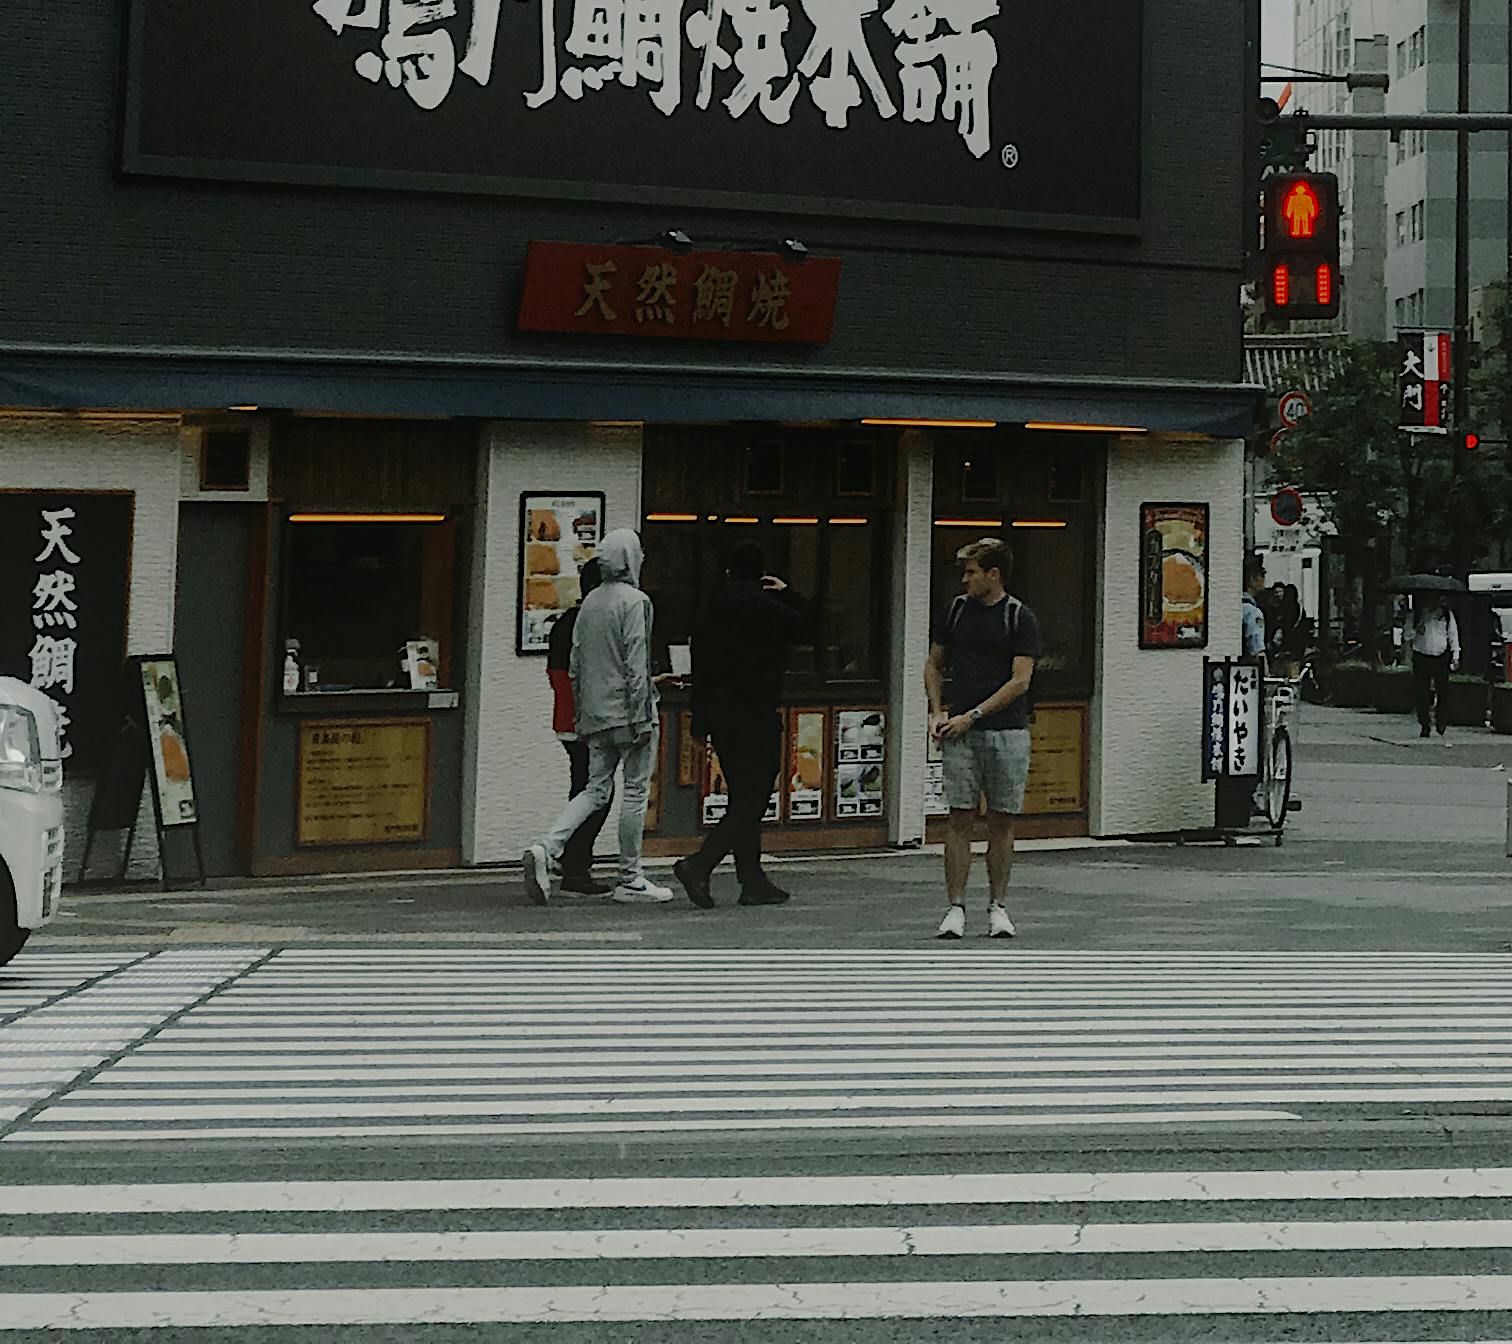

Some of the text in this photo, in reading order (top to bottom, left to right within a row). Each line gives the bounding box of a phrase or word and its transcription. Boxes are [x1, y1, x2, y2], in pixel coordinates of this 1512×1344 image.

[573, 260, 791, 331] 天然鯛焼
[1399, 350, 1425, 411] 大門
[28, 506, 82, 760] 天然鯛
[1233, 670, 1249, 772] たいやき
